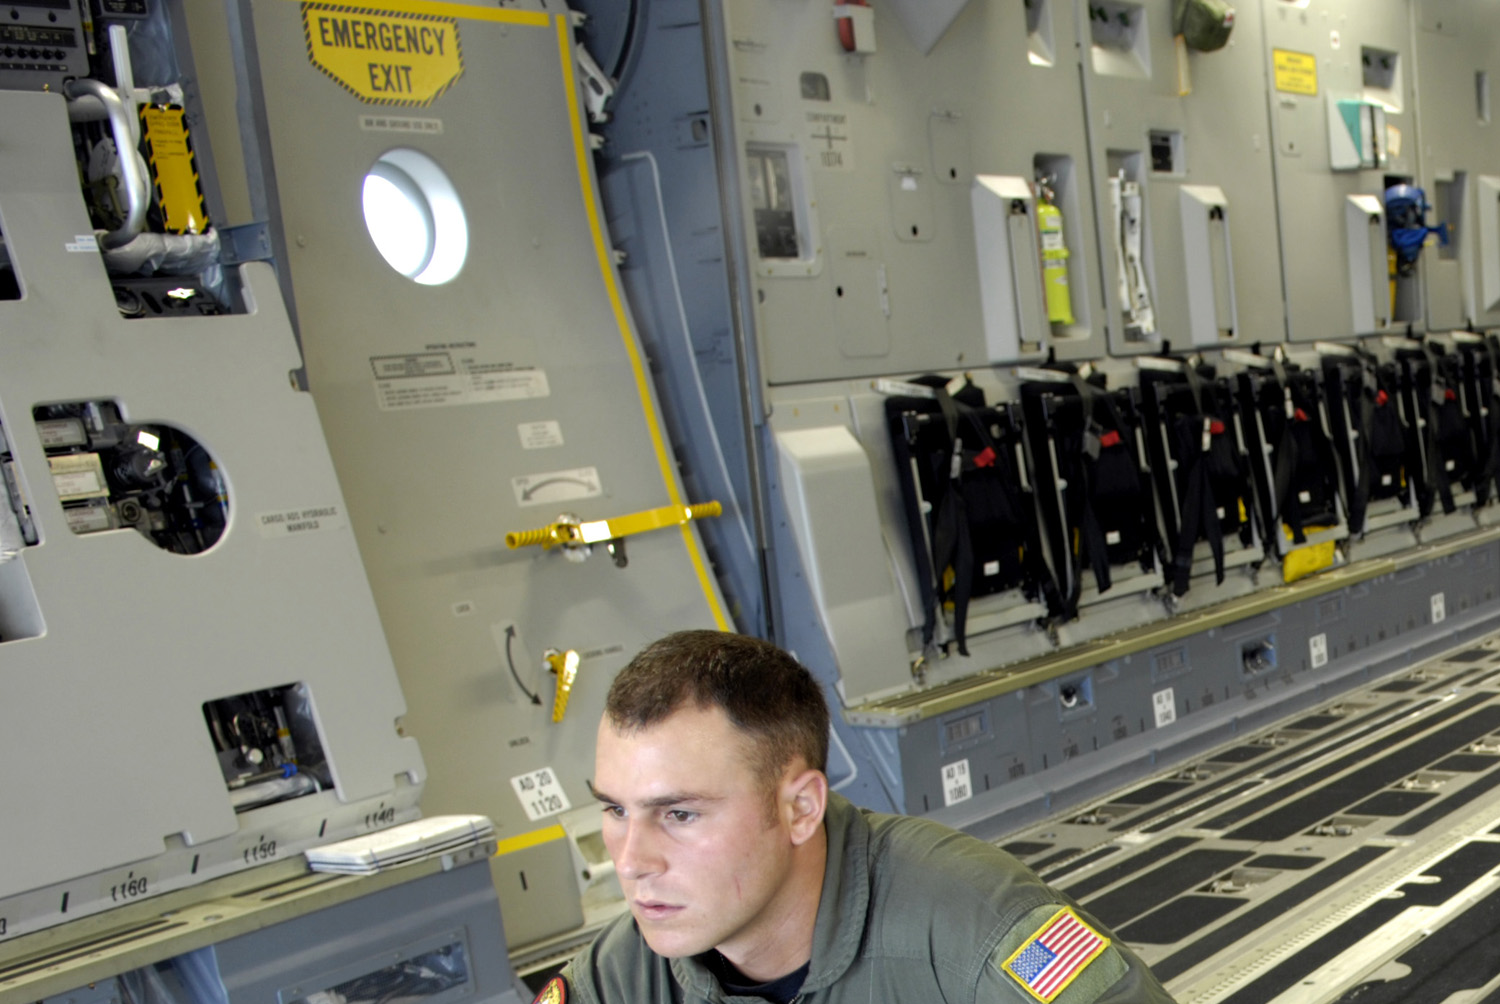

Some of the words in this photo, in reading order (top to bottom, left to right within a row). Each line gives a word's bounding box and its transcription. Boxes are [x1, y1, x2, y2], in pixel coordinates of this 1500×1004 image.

[318, 17, 445, 56] EMERGENCY
[368, 63, 412, 93] EXIT
[261, 513, 285, 525] CARGO
[519, 776, 535, 791] AD
[535, 771, 552, 787] 20
[946, 765, 955, 780] AD
[531, 794, 563, 815] 1120
[365, 807, 395, 829] 1140
[243, 840, 277, 864] 1150
[111, 876, 148, 902] 1160
